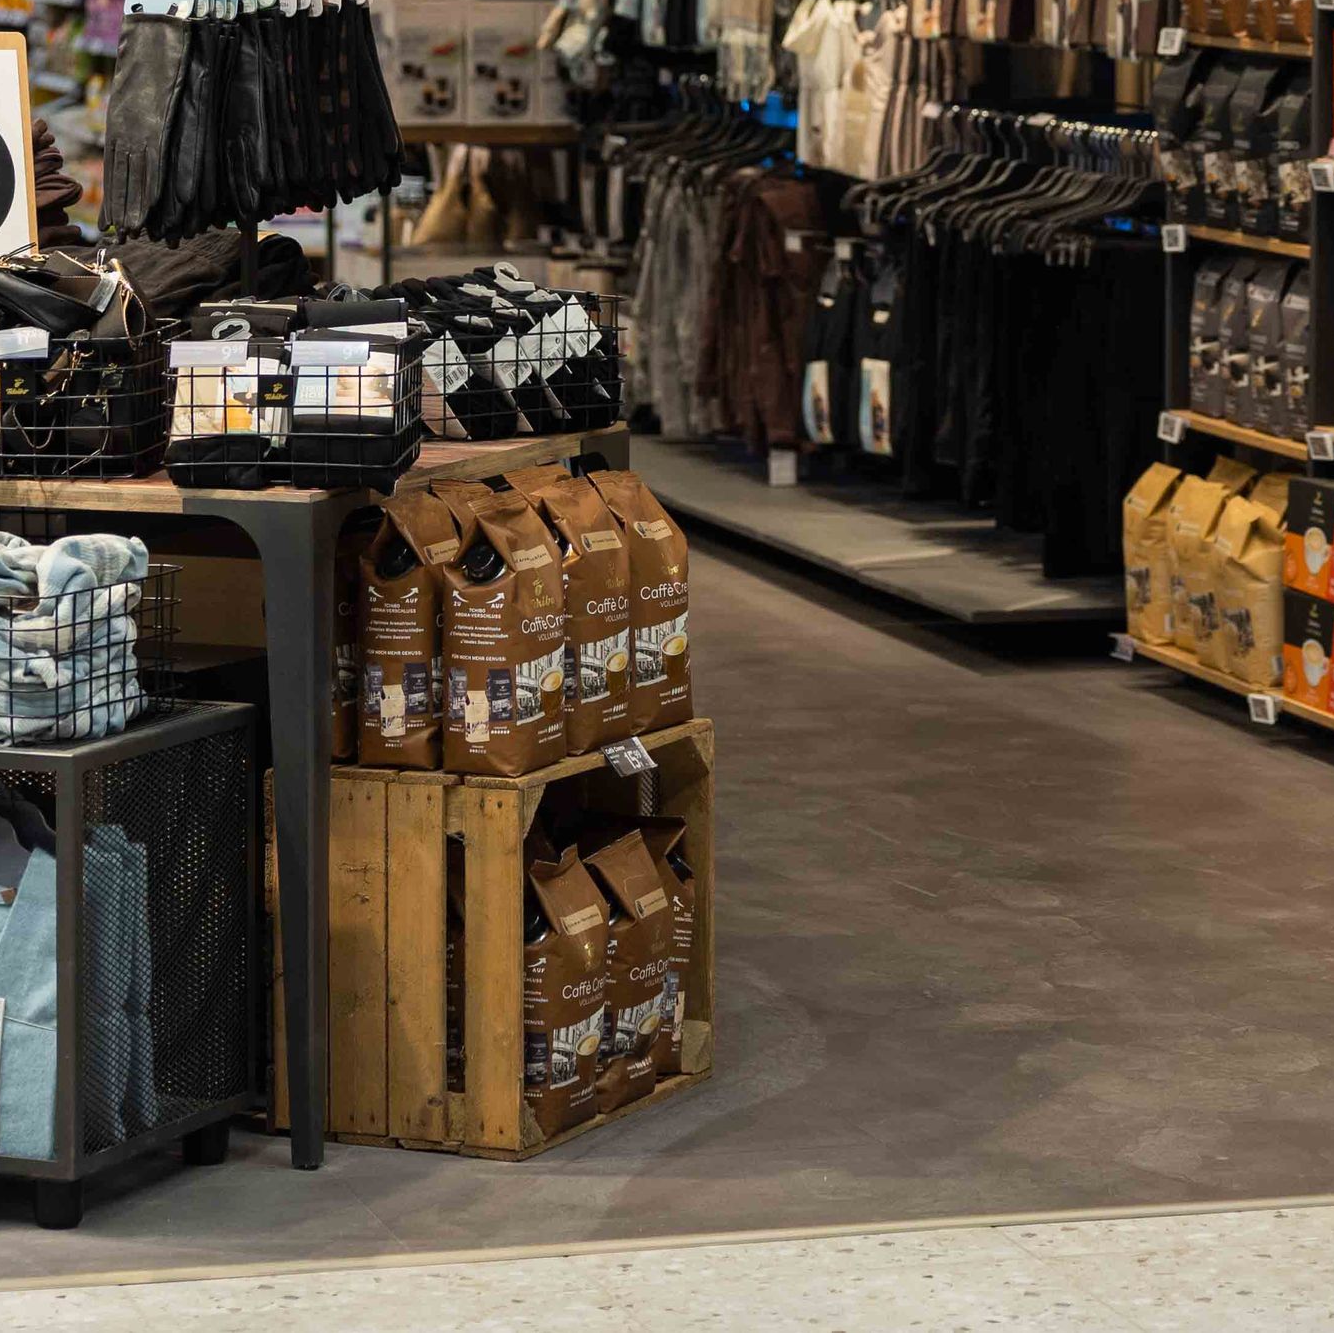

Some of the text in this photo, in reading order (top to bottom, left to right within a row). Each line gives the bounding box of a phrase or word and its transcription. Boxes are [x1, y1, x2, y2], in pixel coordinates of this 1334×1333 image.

[5, 388, 29, 396] Tchibo
[264, 392, 287, 401] Tchibo
[640, 581, 674, 601] Caffè
[586, 597, 616, 615] Caffè
[521, 616, 547, 634] Caffè
[629, 961, 656, 981] Caffè
[562, 979, 591, 1000] Caffè
